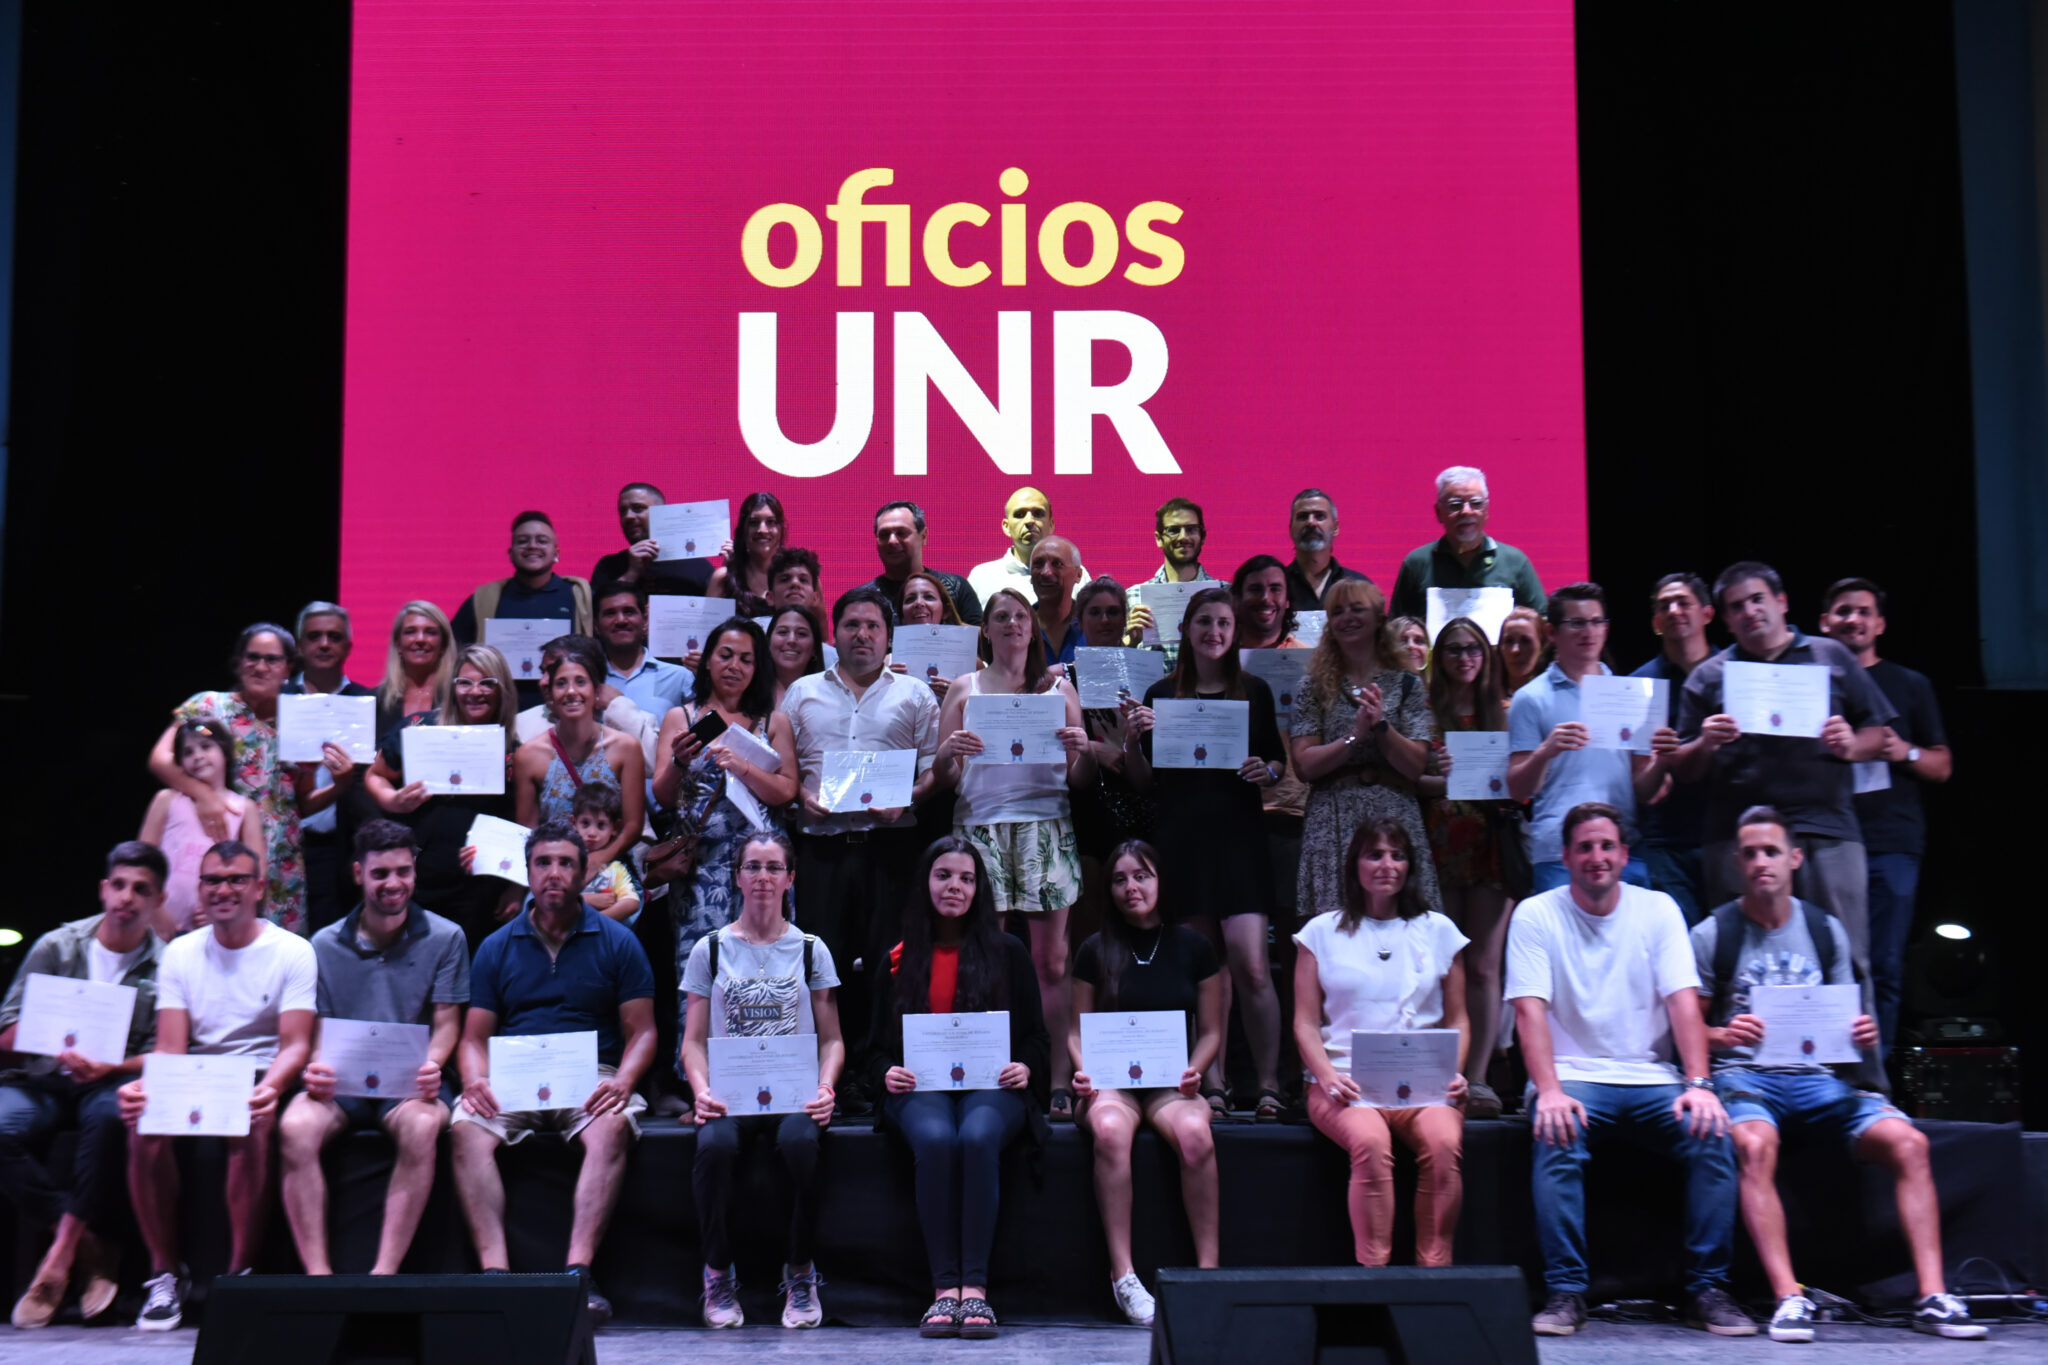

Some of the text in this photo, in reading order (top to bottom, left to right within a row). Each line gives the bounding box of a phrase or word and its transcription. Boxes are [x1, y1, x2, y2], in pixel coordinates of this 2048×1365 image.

[741, 167, 1185, 287] oficios
[738, 310, 1183, 478] UNR
[742, 1007, 780, 1018] VISION
